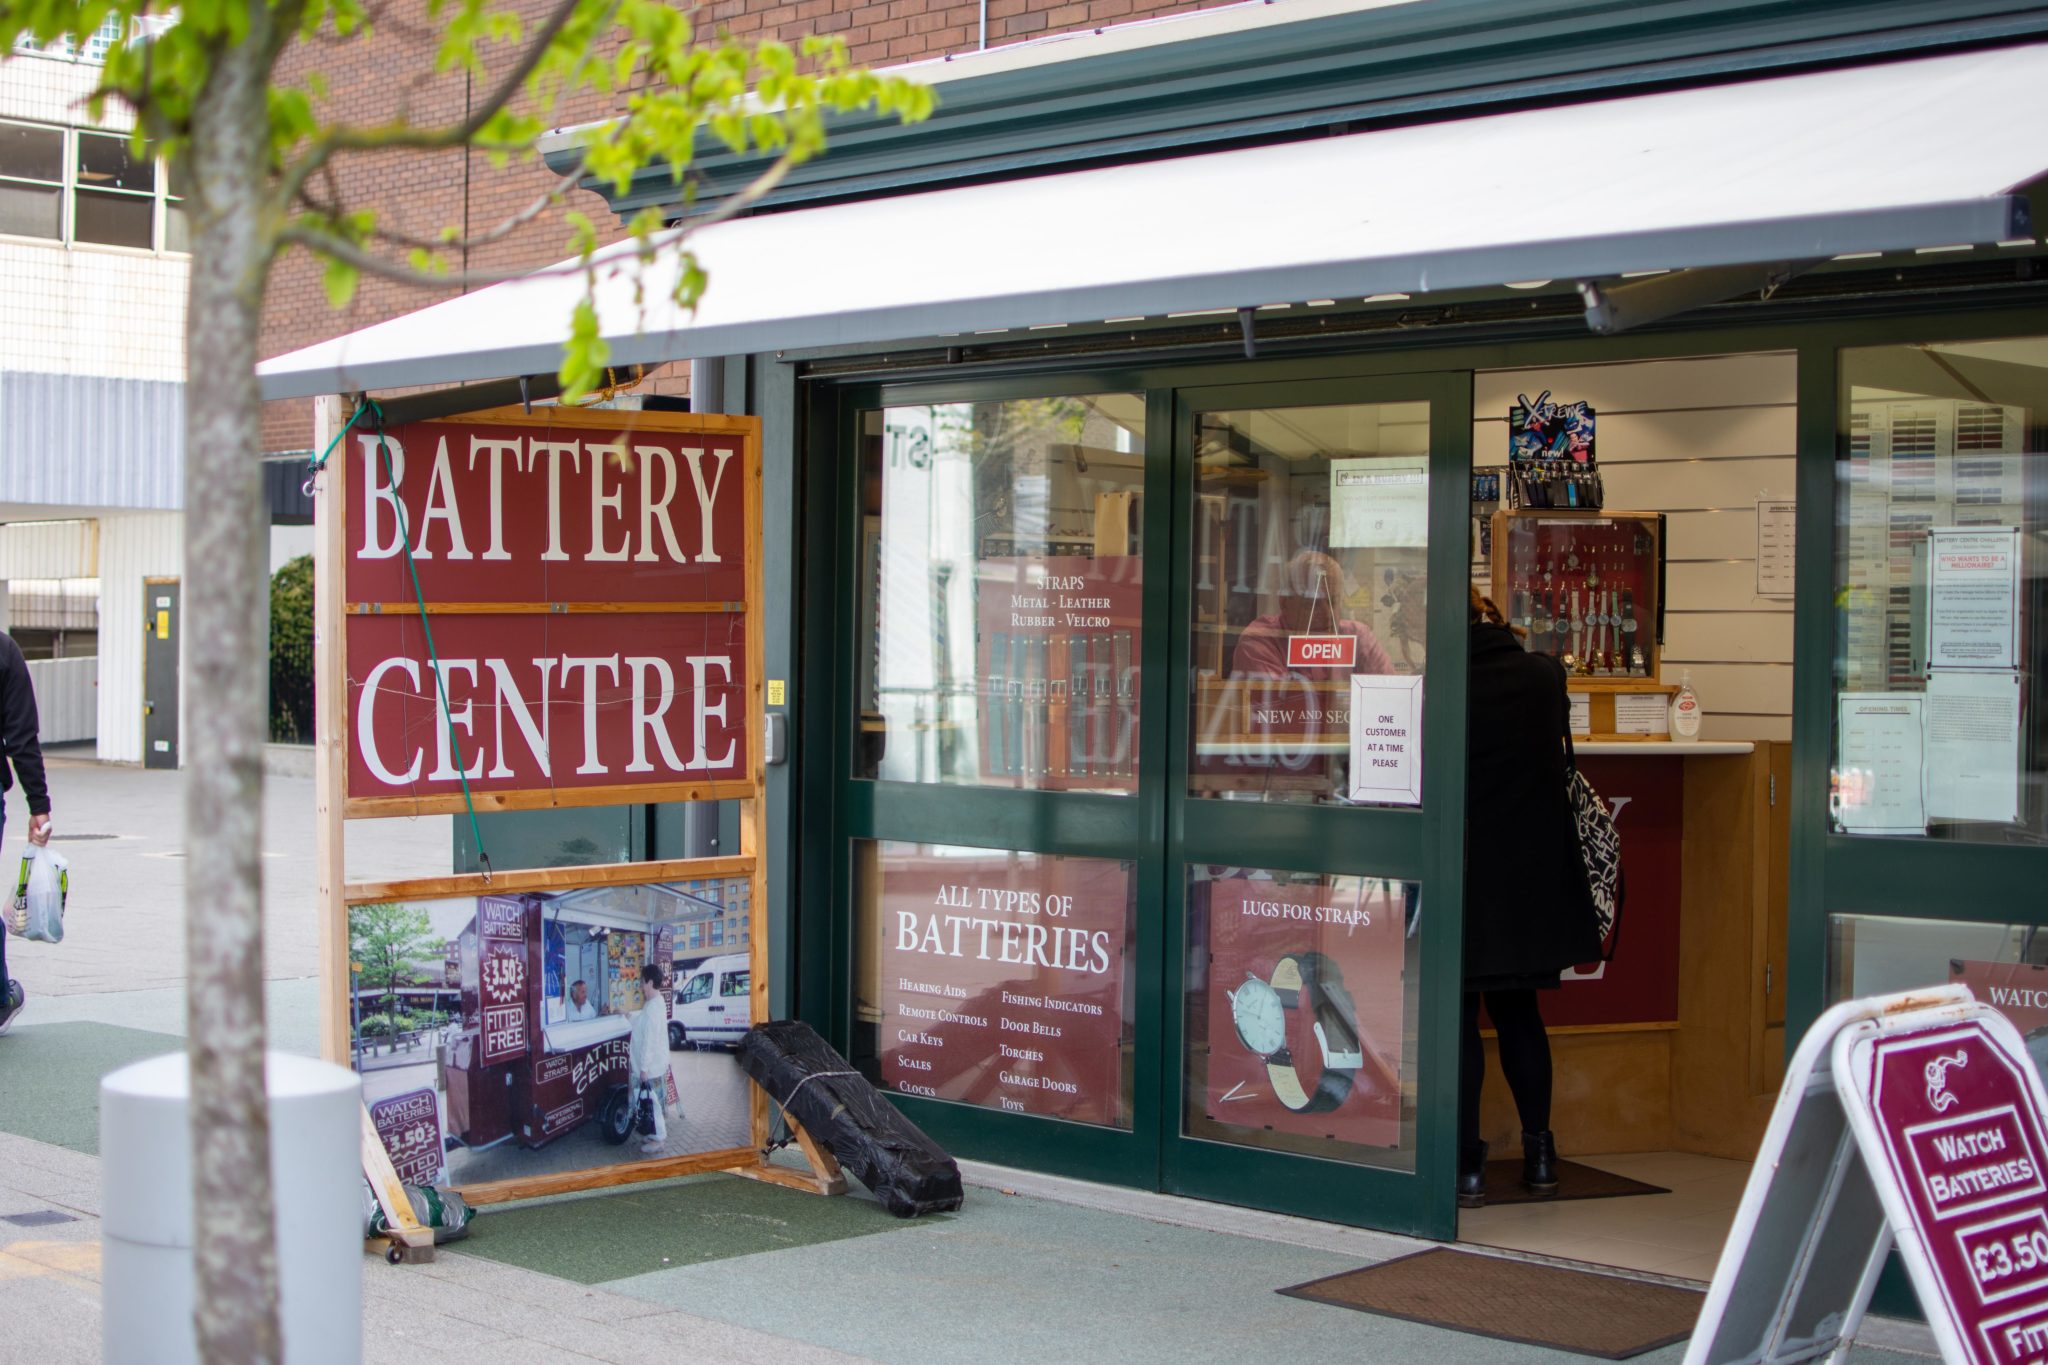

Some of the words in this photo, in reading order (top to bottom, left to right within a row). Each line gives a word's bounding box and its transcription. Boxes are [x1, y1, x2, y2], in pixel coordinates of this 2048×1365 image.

[357, 434, 733, 563] BATTERY
[1037, 576, 1084, 590] STRAPS
[1011, 595, 1049, 609] METAL
[1059, 595, 1111, 609] LEATHER
[1011, 613, 1055, 627] RUBBER
[1065, 613, 1110, 627] VELCRO
[1301, 643, 1341, 659] OPEN
[357, 653, 736, 785] CENTRE
[1257, 710, 1295, 724] NEW
[1299, 710, 1322, 720] AND
[1326, 711, 1351, 724] SEC
[1378, 715, 1394, 723] ONE
[1366, 728, 1406, 737] CUSTOMER
[1367, 743, 1377, 751] AT
[1378, 744, 1384, 752] A
[1386, 744, 1404, 752] TIME
[1372, 759, 1398, 767] PLEASE
[935, 884, 972, 908] ALL
[977, 888, 1040, 915] TYPES
[1045, 895, 1073, 918] OF
[485, 902, 519, 923] WATCH
[1242, 900, 1279, 918] LUGS
[1282, 904, 1312, 921] FOR
[1315, 907, 1370, 926] STRAPS
[484, 921, 521, 937] BATTERIES
[895, 911, 1109, 974] BATTERIES
[492, 959, 516, 985] 3.50
[899, 978, 941, 995] HEARING
[943, 983, 967, 998] AIDS
[1989, 986, 2048, 1009] WATC
[1002, 991, 1042, 1008] FISHING
[1044, 996, 1102, 1015] INDICATORS
[487, 1007, 523, 1031] FITTED
[899, 1004, 936, 1020] REMOTE
[938, 1009, 987, 1027] CONTROLS
[898, 1030, 918, 1044] CAR
[920, 1032, 943, 1047] KEYS
[1000, 1017, 1030, 1033] DOOR
[1032, 1021, 1061, 1038] BELLS
[488, 1027, 524, 1052] FREE
[545, 1057, 567, 1069] WATCH
[572, 1040, 630, 1084] BATTER
[898, 1055, 931, 1071] SCALES
[999, 1044, 1043, 1062] TORCHES
[543, 1066, 569, 1080] STRAPS
[576, 1056, 628, 1094] CENTR
[999, 1071, 1039, 1088] GARAGE
[1042, 1077, 1077, 1093] DOORS
[899, 1080, 935, 1096] CLOCKS
[378, 1095, 430, 1118] WATCH
[1000, 1096, 1024, 1111] TOYS
[377, 1104, 432, 1128] BATTERIES
[389, 1127, 425, 1153] 3.50
[1932, 1128, 2006, 1162] WATCH
[396, 1152, 437, 1178] TTED
[1929, 1158, 2034, 1202] BATTERIES
[1973, 1231, 2048, 1282] £3.50
